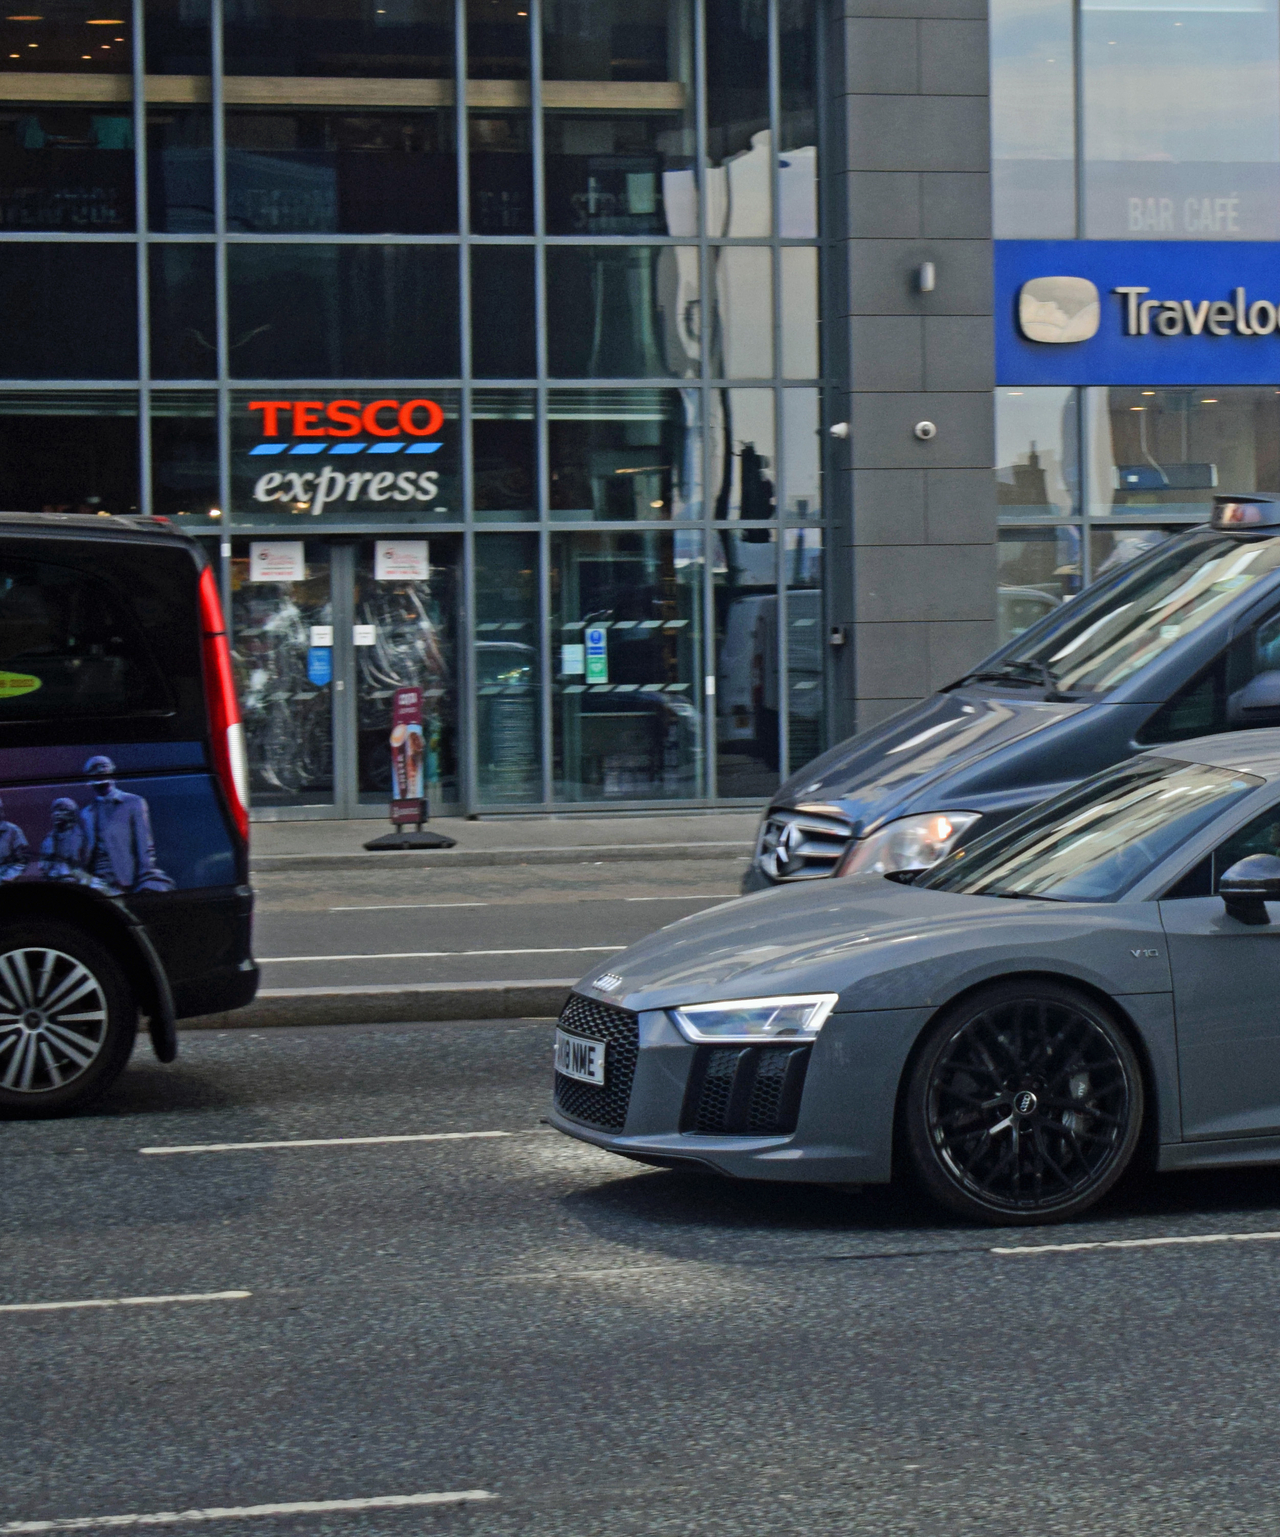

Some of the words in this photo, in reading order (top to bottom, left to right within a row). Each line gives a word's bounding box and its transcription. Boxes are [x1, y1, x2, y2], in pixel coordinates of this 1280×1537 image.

[1128, 197, 1175, 232] BAR
[1184, 191, 1240, 232] CAFÉ
[248, 399, 444, 437] TESCO
[253, 465, 440, 515] express
[1130, 948, 1159, 958] V10
[572, 1041, 596, 1076] NME
